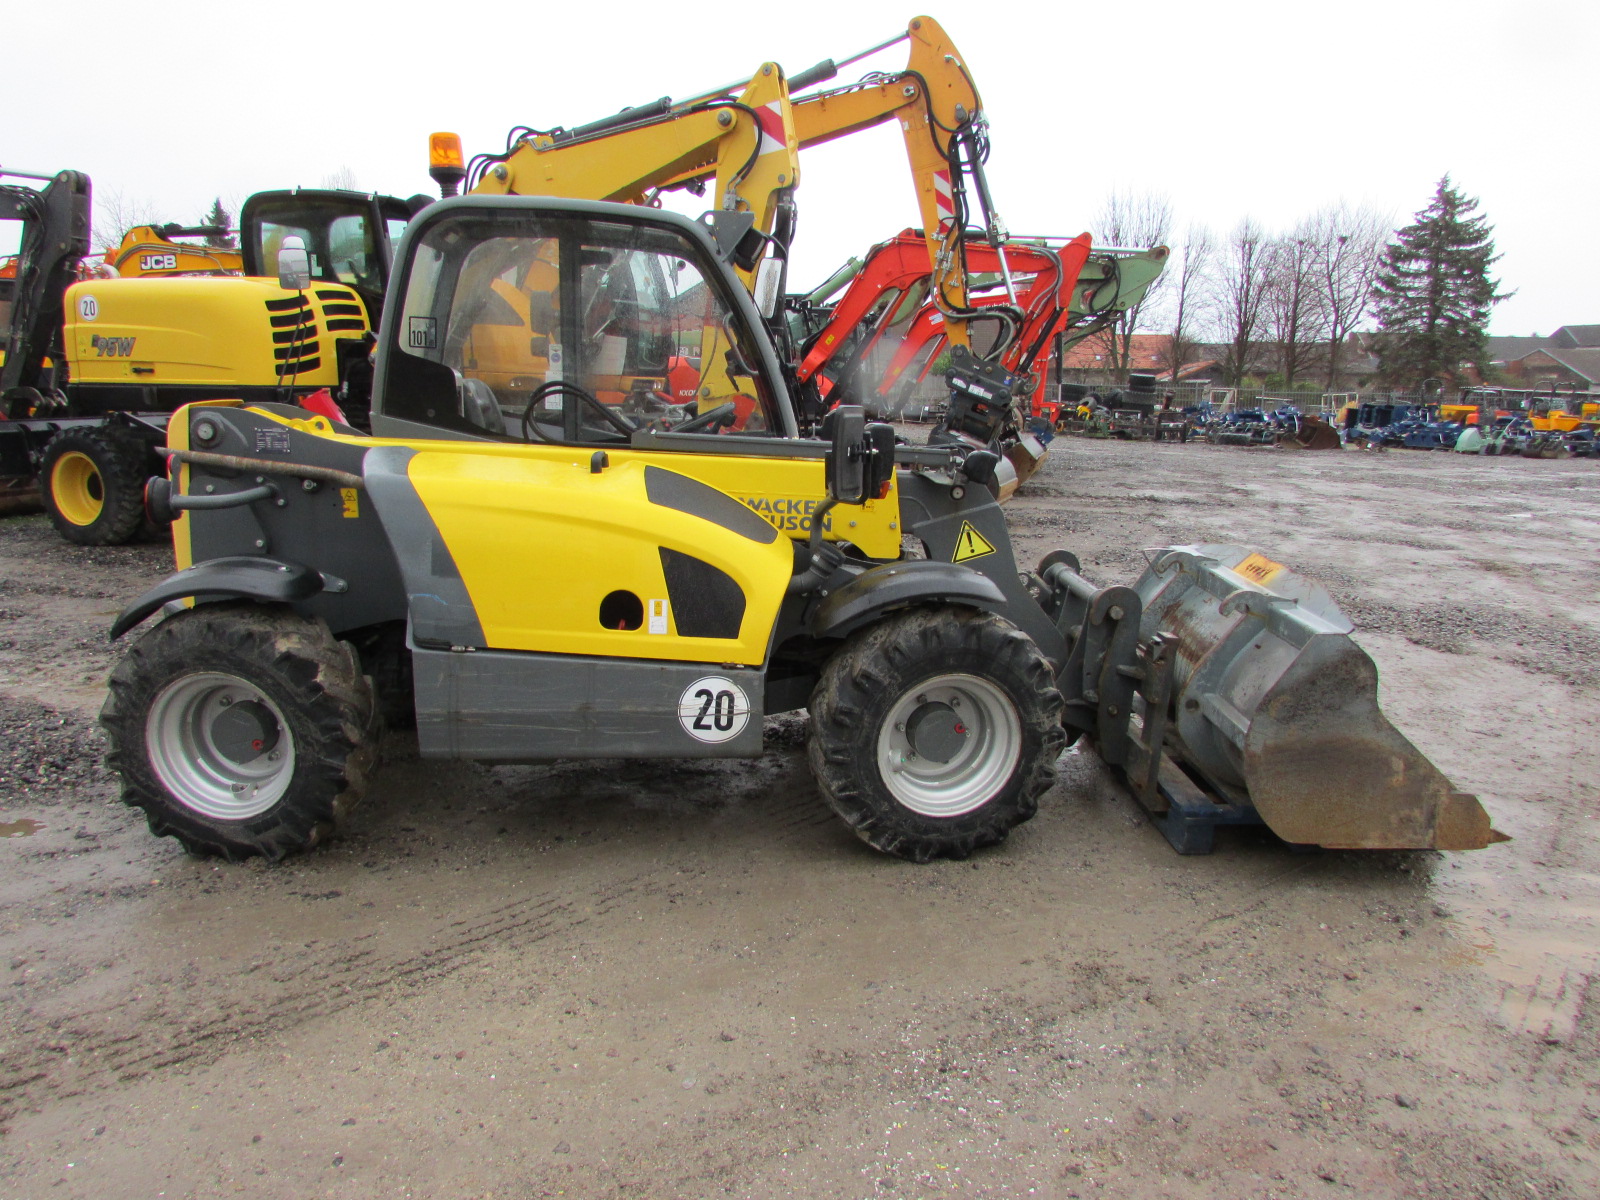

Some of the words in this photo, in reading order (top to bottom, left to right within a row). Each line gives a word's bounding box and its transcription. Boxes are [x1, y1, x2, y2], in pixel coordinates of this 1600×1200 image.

[141, 254, 178, 271] JCB
[83, 300, 96, 316] 20
[412, 330, 427, 346] 101
[762, 515, 832, 532] USON
[693, 688, 736, 732] 20
